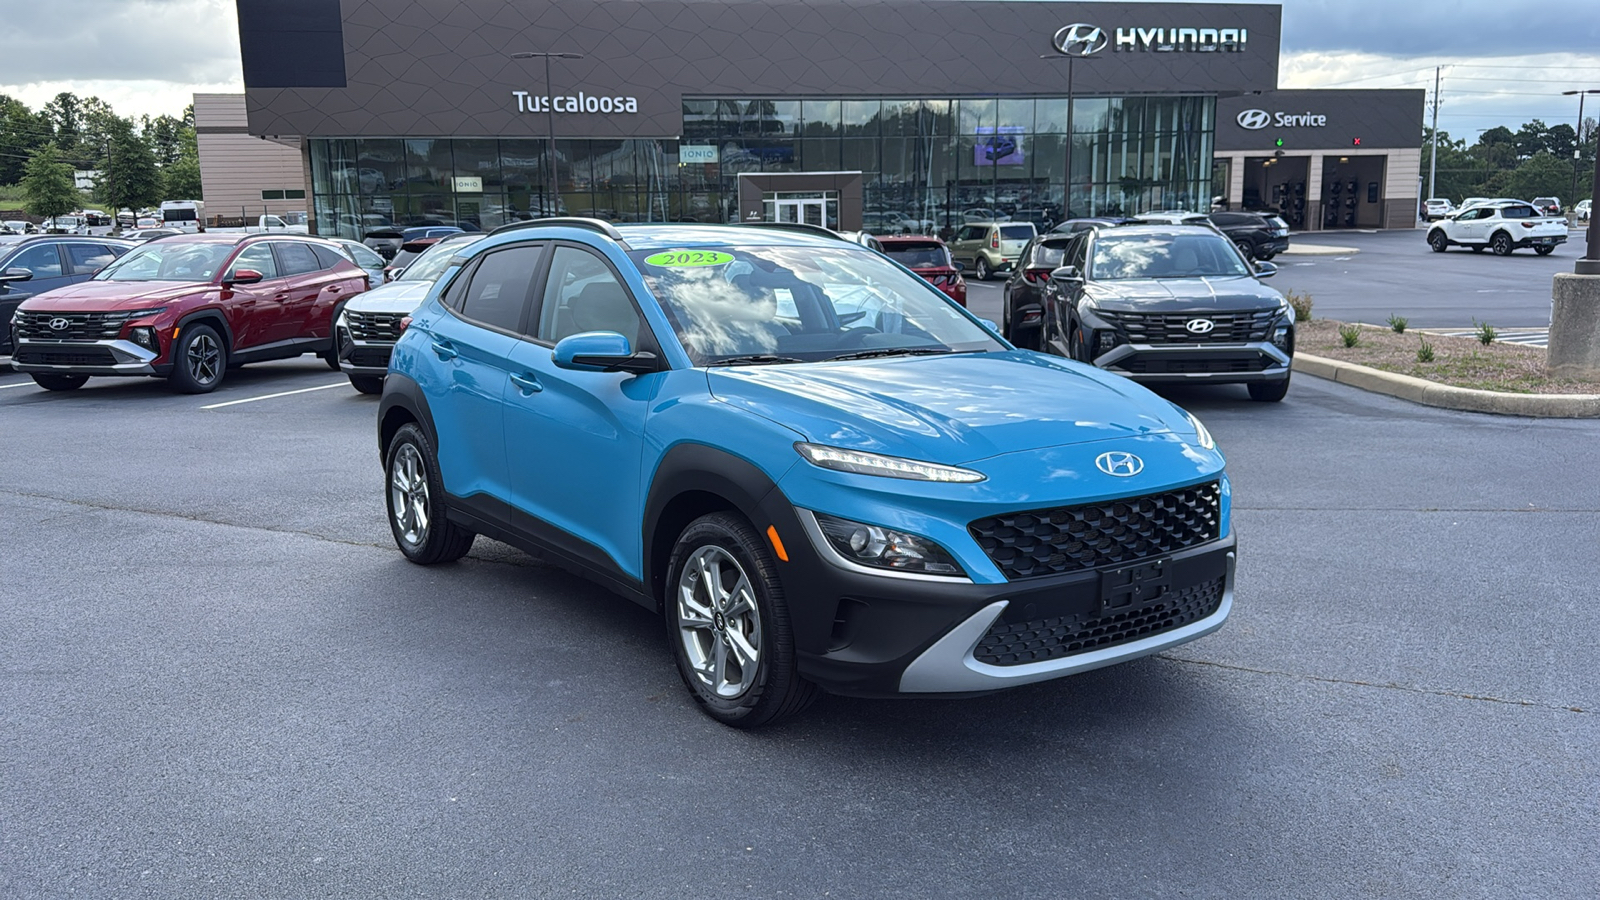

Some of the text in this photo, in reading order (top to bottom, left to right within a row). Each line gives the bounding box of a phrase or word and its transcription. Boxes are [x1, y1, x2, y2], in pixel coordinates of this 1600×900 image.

[1116, 27, 1247, 51] HYUNDAI
[512, 91, 638, 113] Tuscaloosa
[1274, 111, 1327, 127] Service
[663, 252, 719, 265] 2023
